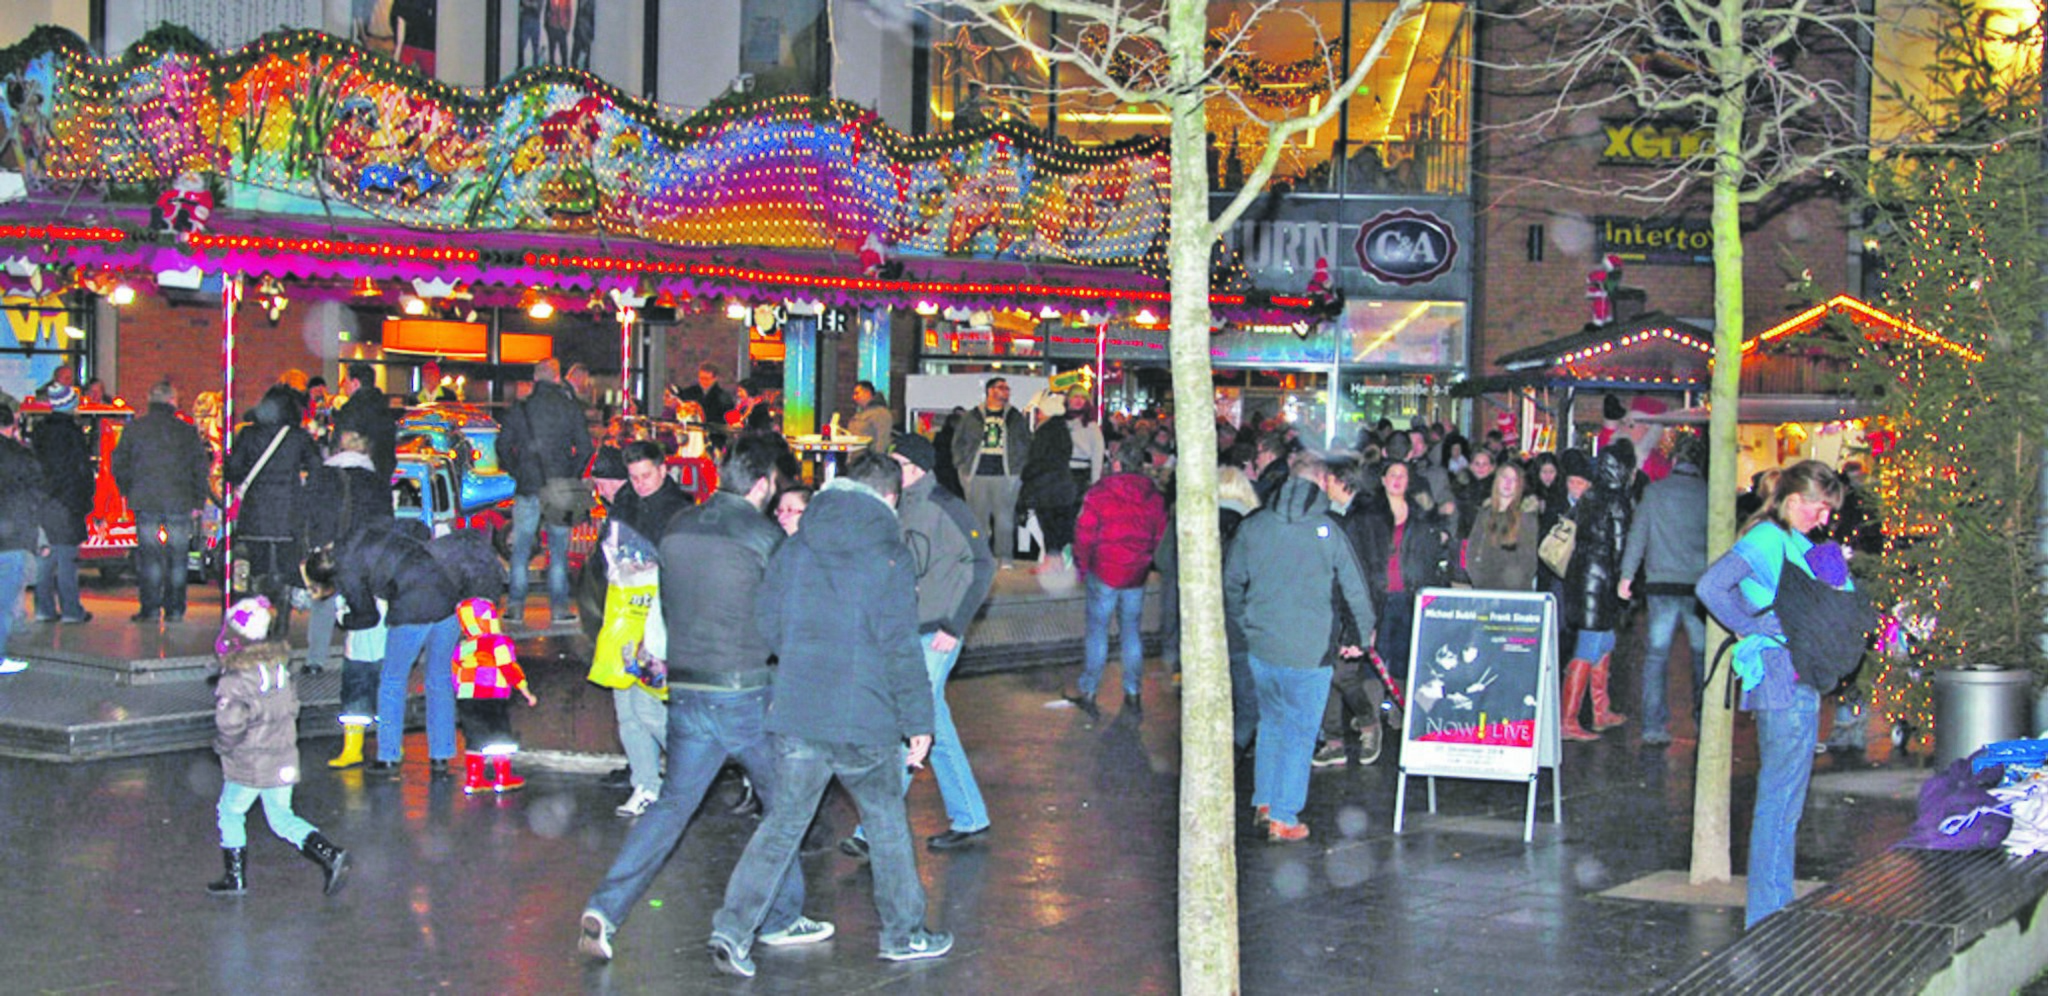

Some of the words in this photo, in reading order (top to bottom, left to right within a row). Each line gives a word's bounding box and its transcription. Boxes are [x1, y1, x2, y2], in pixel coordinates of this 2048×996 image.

[1375, 230, 1438, 263] C&A
[1489, 611, 1511, 622] Frank
[1513, 612, 1540, 624] Sinatra
